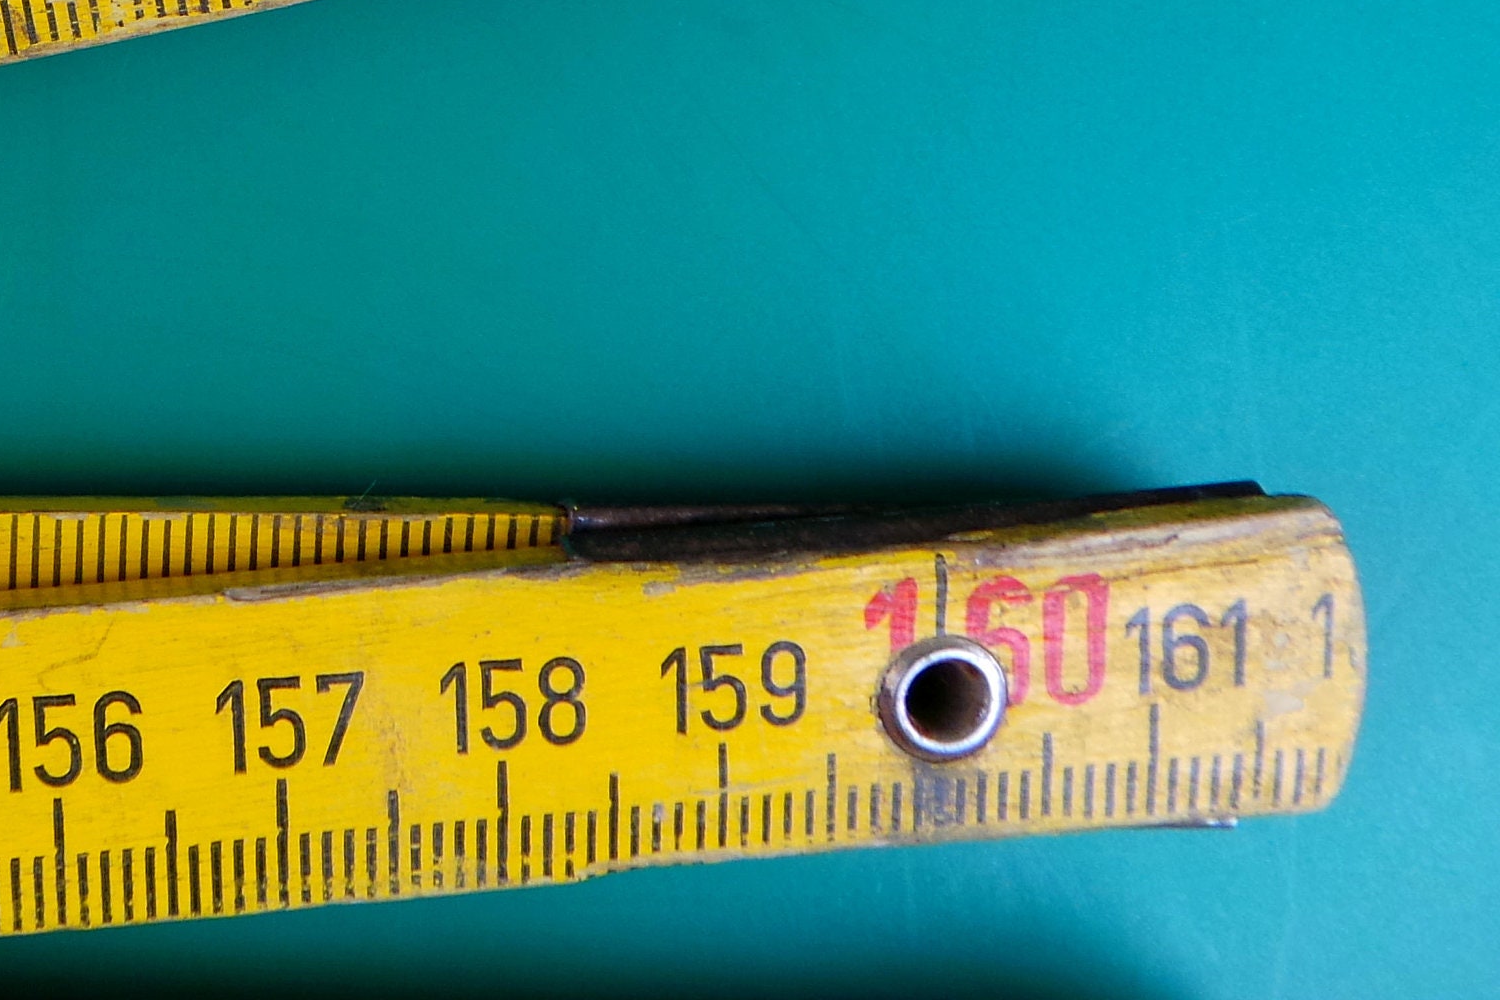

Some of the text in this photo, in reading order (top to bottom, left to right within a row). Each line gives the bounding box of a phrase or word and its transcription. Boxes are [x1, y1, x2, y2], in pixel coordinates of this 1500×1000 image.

[214, 670, 365, 775] 157
[439, 656, 587, 756] 158
[660, 640, 808, 735] 159
[1124, 598, 1249, 696] 161
